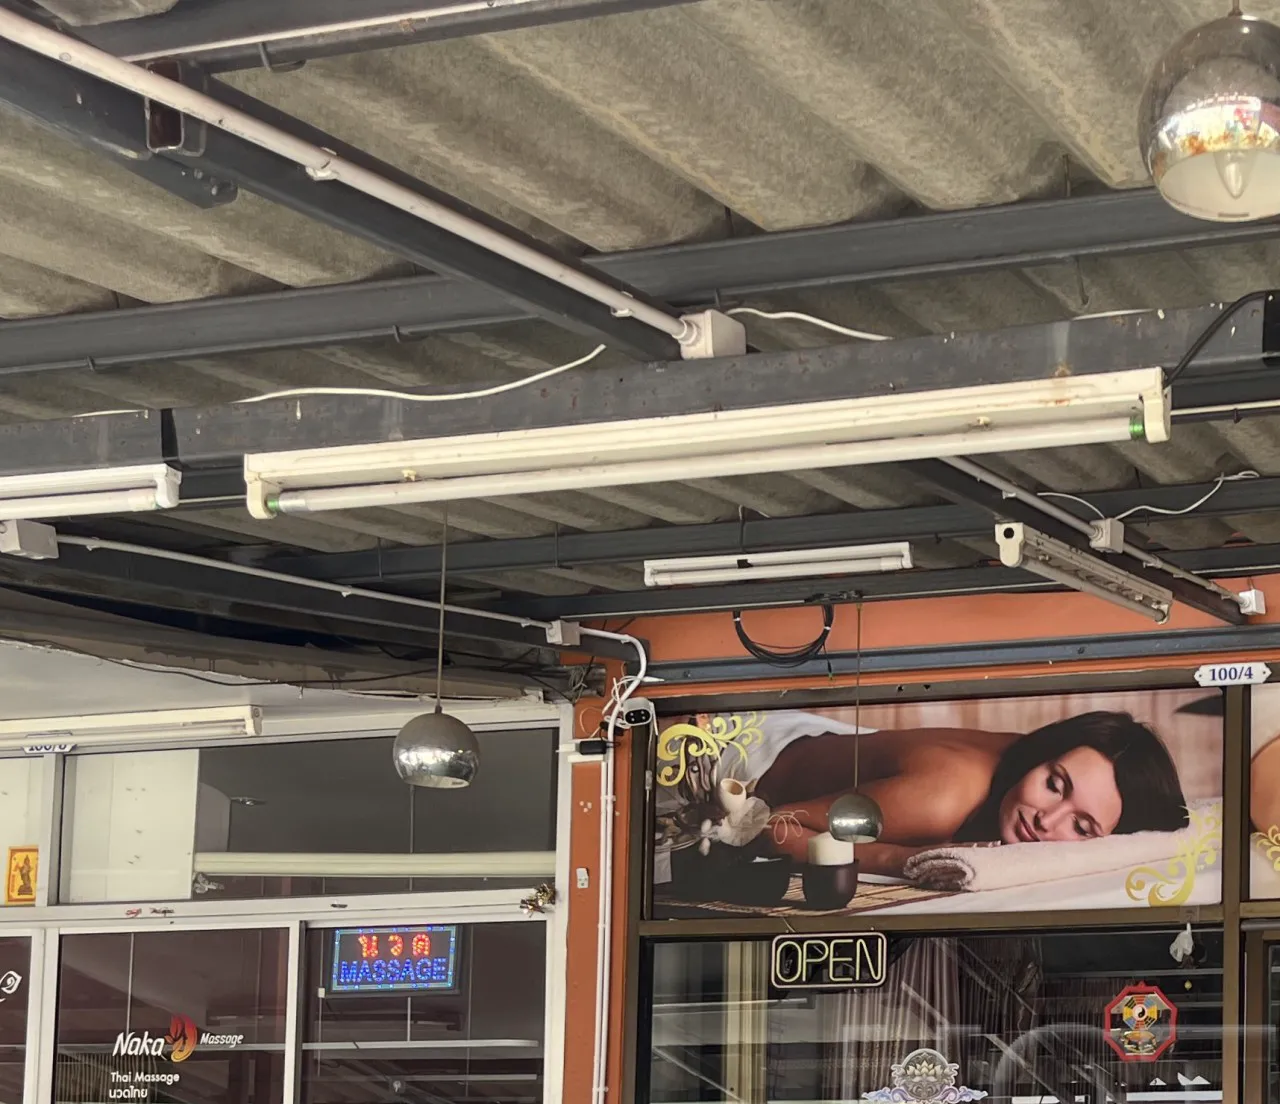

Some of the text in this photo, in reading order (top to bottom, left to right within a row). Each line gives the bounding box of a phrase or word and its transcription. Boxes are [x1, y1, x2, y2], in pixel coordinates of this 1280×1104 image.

[1208, 665, 1254, 681] 100/4
[339, 957, 448, 983] MASSAGE
[775, 937, 883, 983] OPEN
[112, 1030, 244, 1061] Naka Massage
[110, 1071, 180, 1086] Thai Massage
[108, 1085, 148, 1099] นวดไทย
